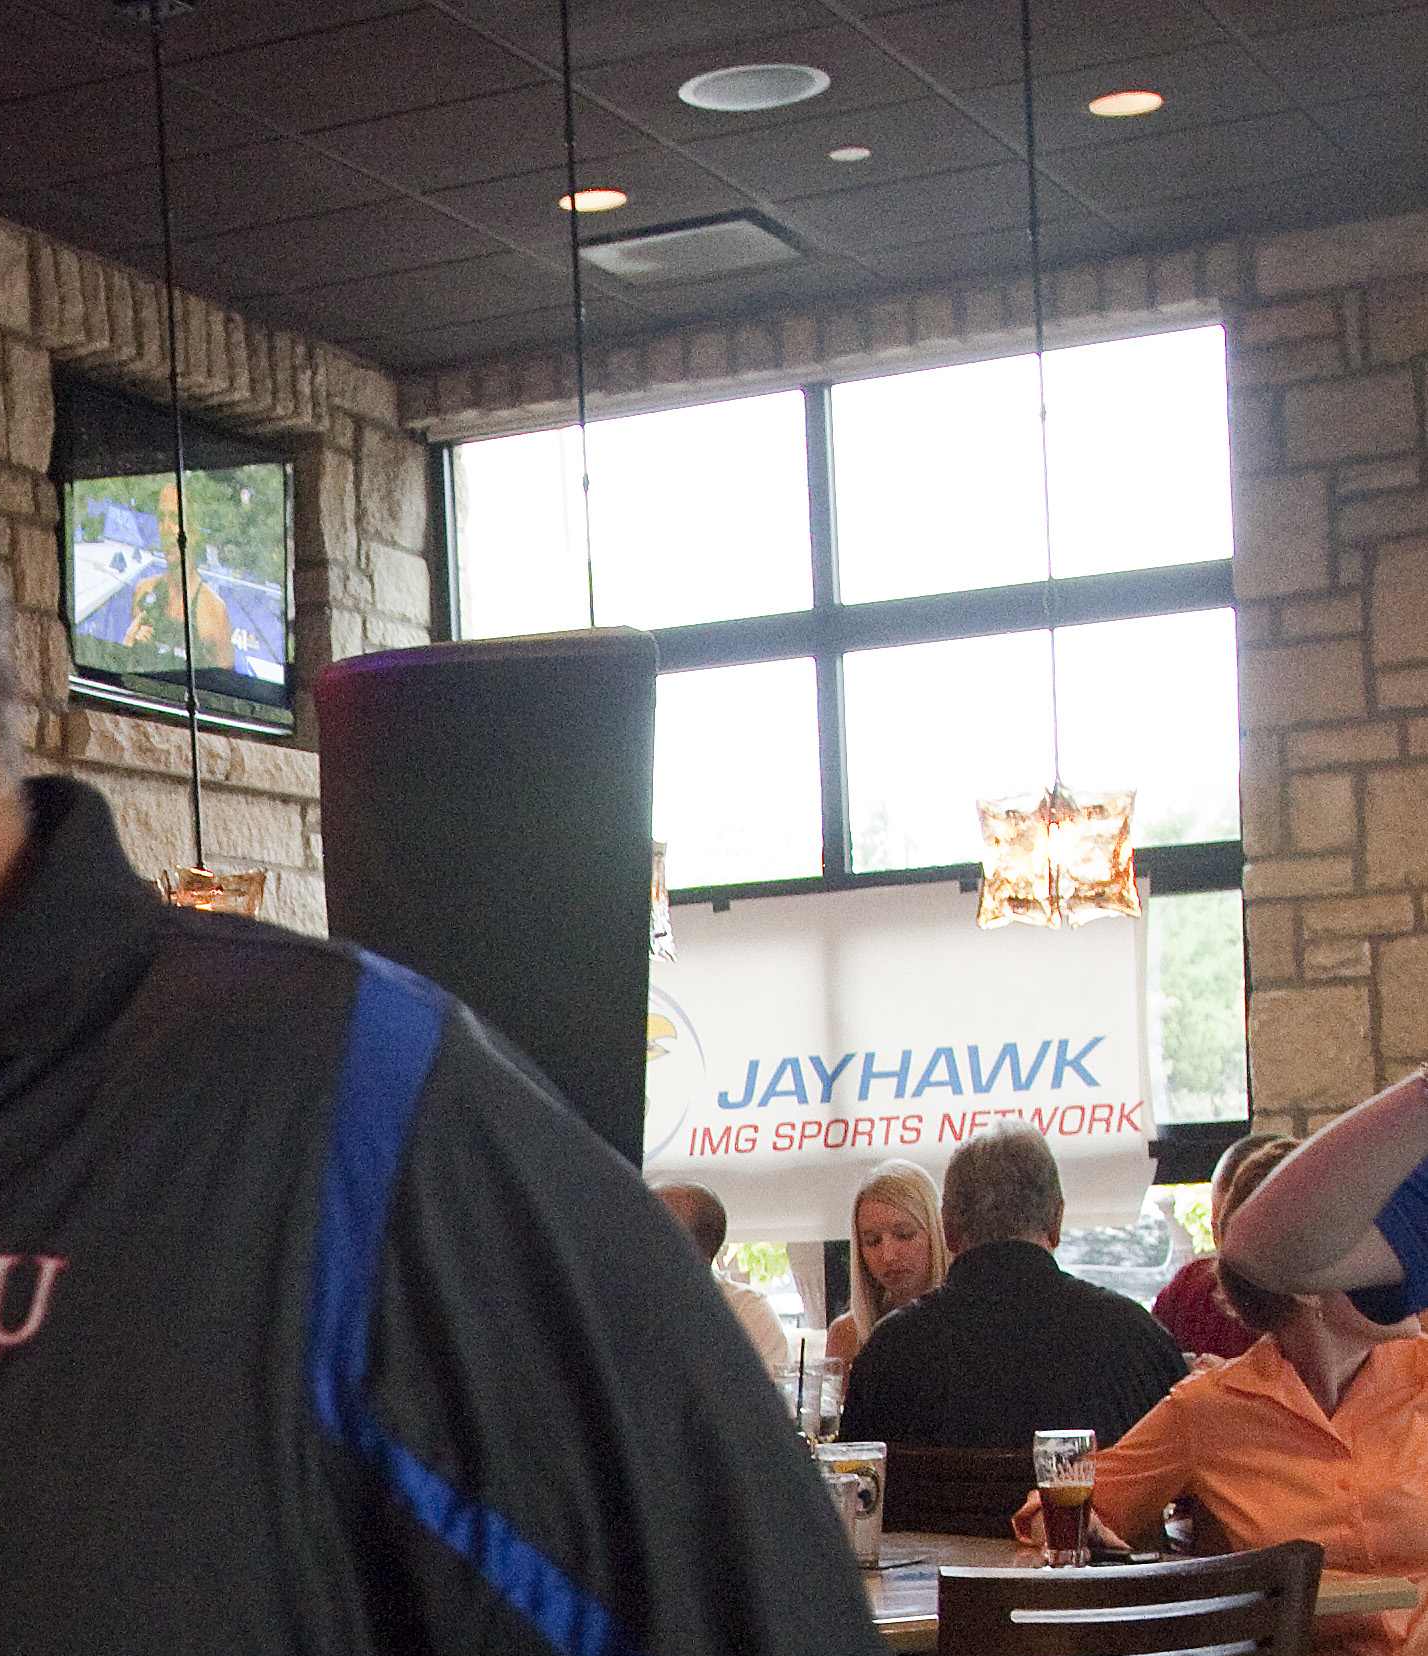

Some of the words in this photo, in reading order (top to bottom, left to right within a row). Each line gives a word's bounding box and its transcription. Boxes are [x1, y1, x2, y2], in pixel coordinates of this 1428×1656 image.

[716, 1035, 1107, 1110] JAYHAWK
[688, 1123, 759, 1157] IMG
[772, 1113, 924, 1152] SPORTS
